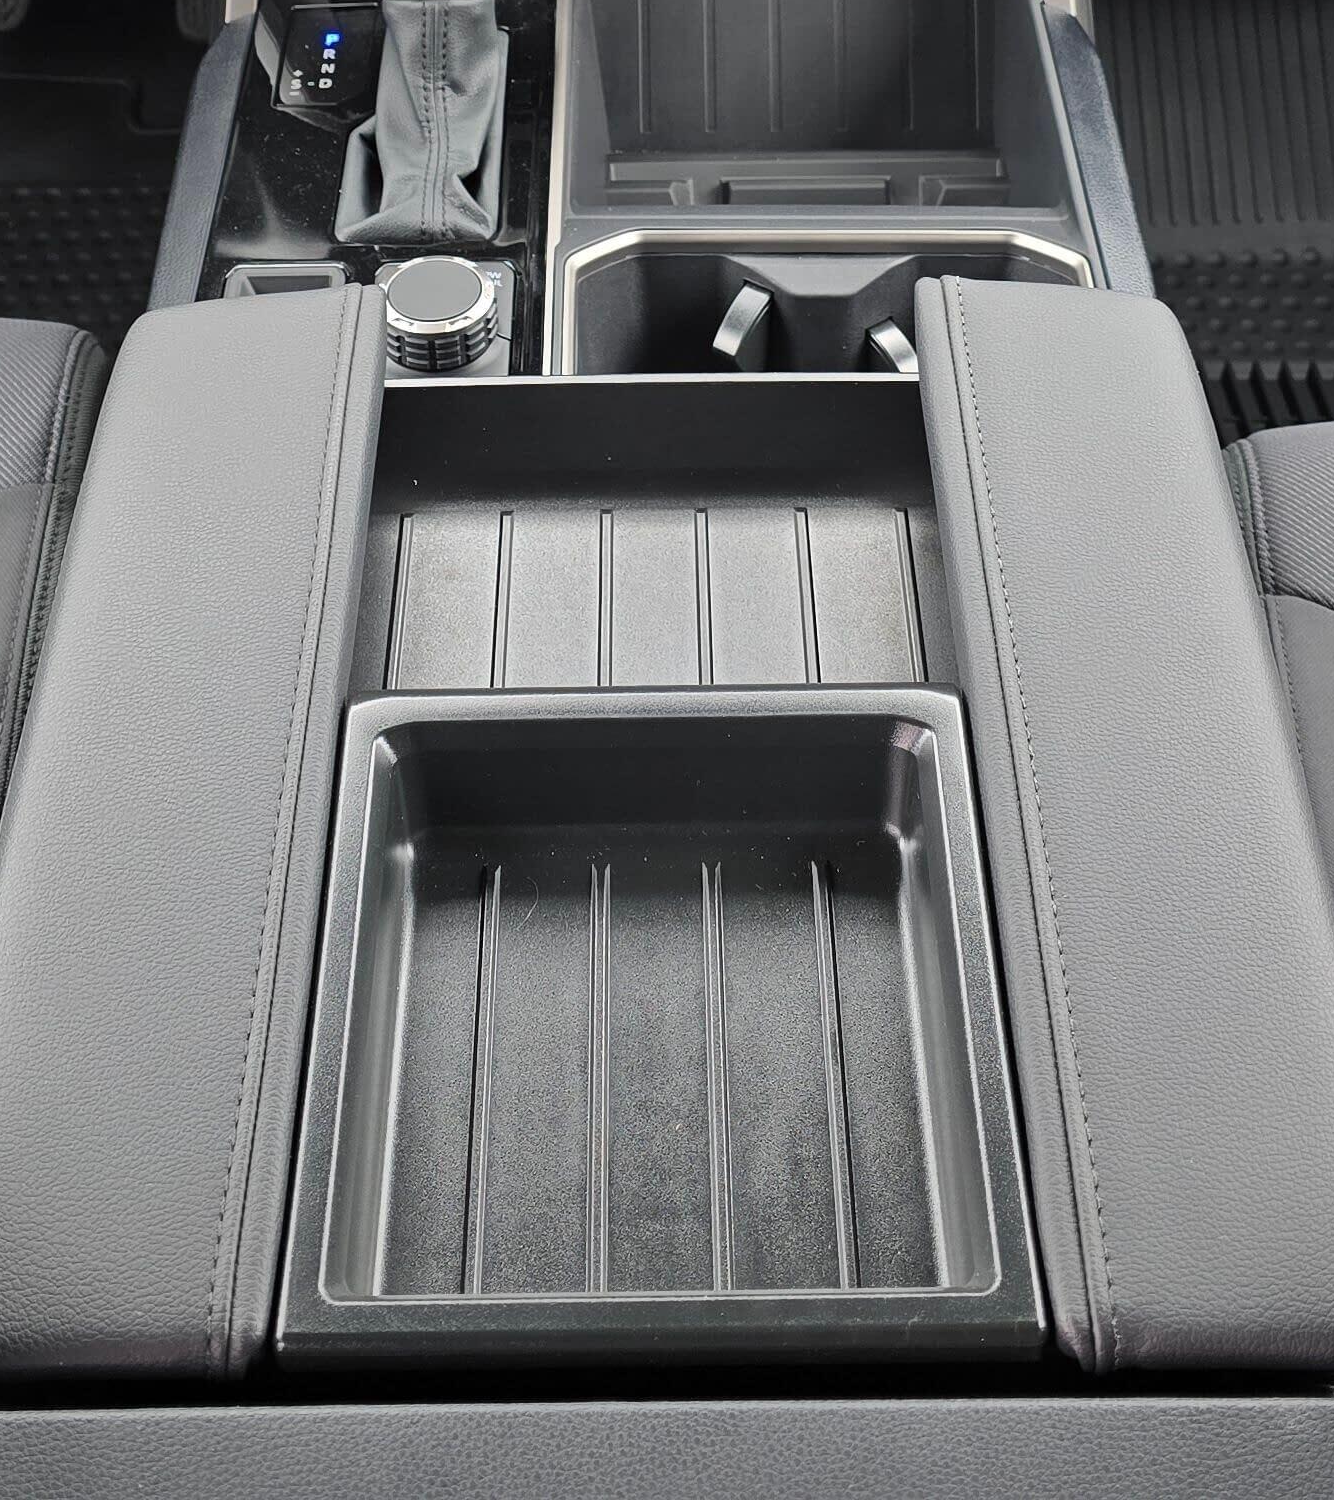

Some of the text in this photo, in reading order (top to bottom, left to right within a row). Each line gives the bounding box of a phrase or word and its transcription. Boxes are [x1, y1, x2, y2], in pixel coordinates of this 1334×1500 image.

[324, 33, 341, 46] P
[322, 48, 336, 60] R
[320, 62, 336, 74] N
[290, 77, 333, 90] S D
